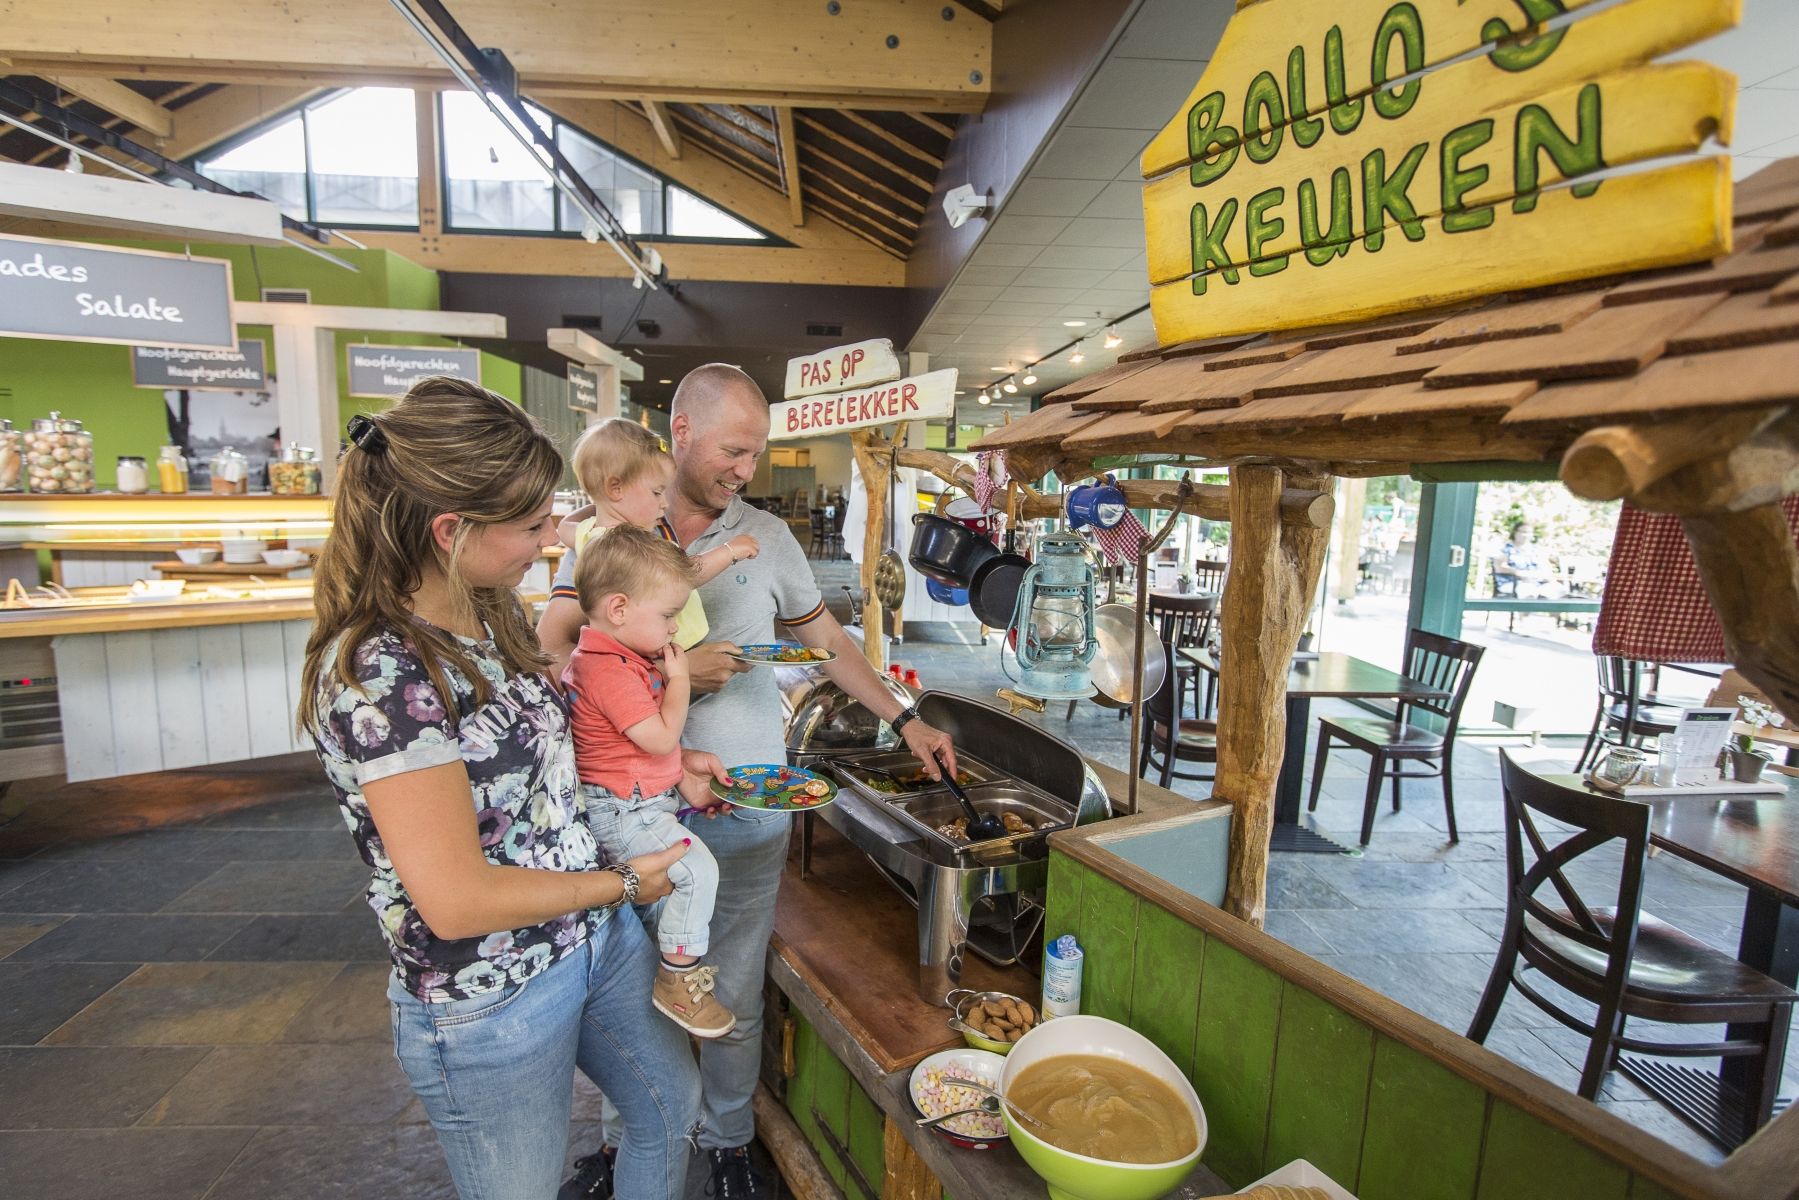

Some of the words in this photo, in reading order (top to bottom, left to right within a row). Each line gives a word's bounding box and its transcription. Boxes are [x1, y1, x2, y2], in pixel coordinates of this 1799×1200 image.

[1190, 83, 1604, 295] KEUKEN
[75, 292, 184, 323] Salate
[354, 354, 460, 372] Hoofdgerechten
[801, 359, 831, 388] PAS
[841, 349, 865, 379] OP
[787, 383, 919, 432] BERELEKKER
